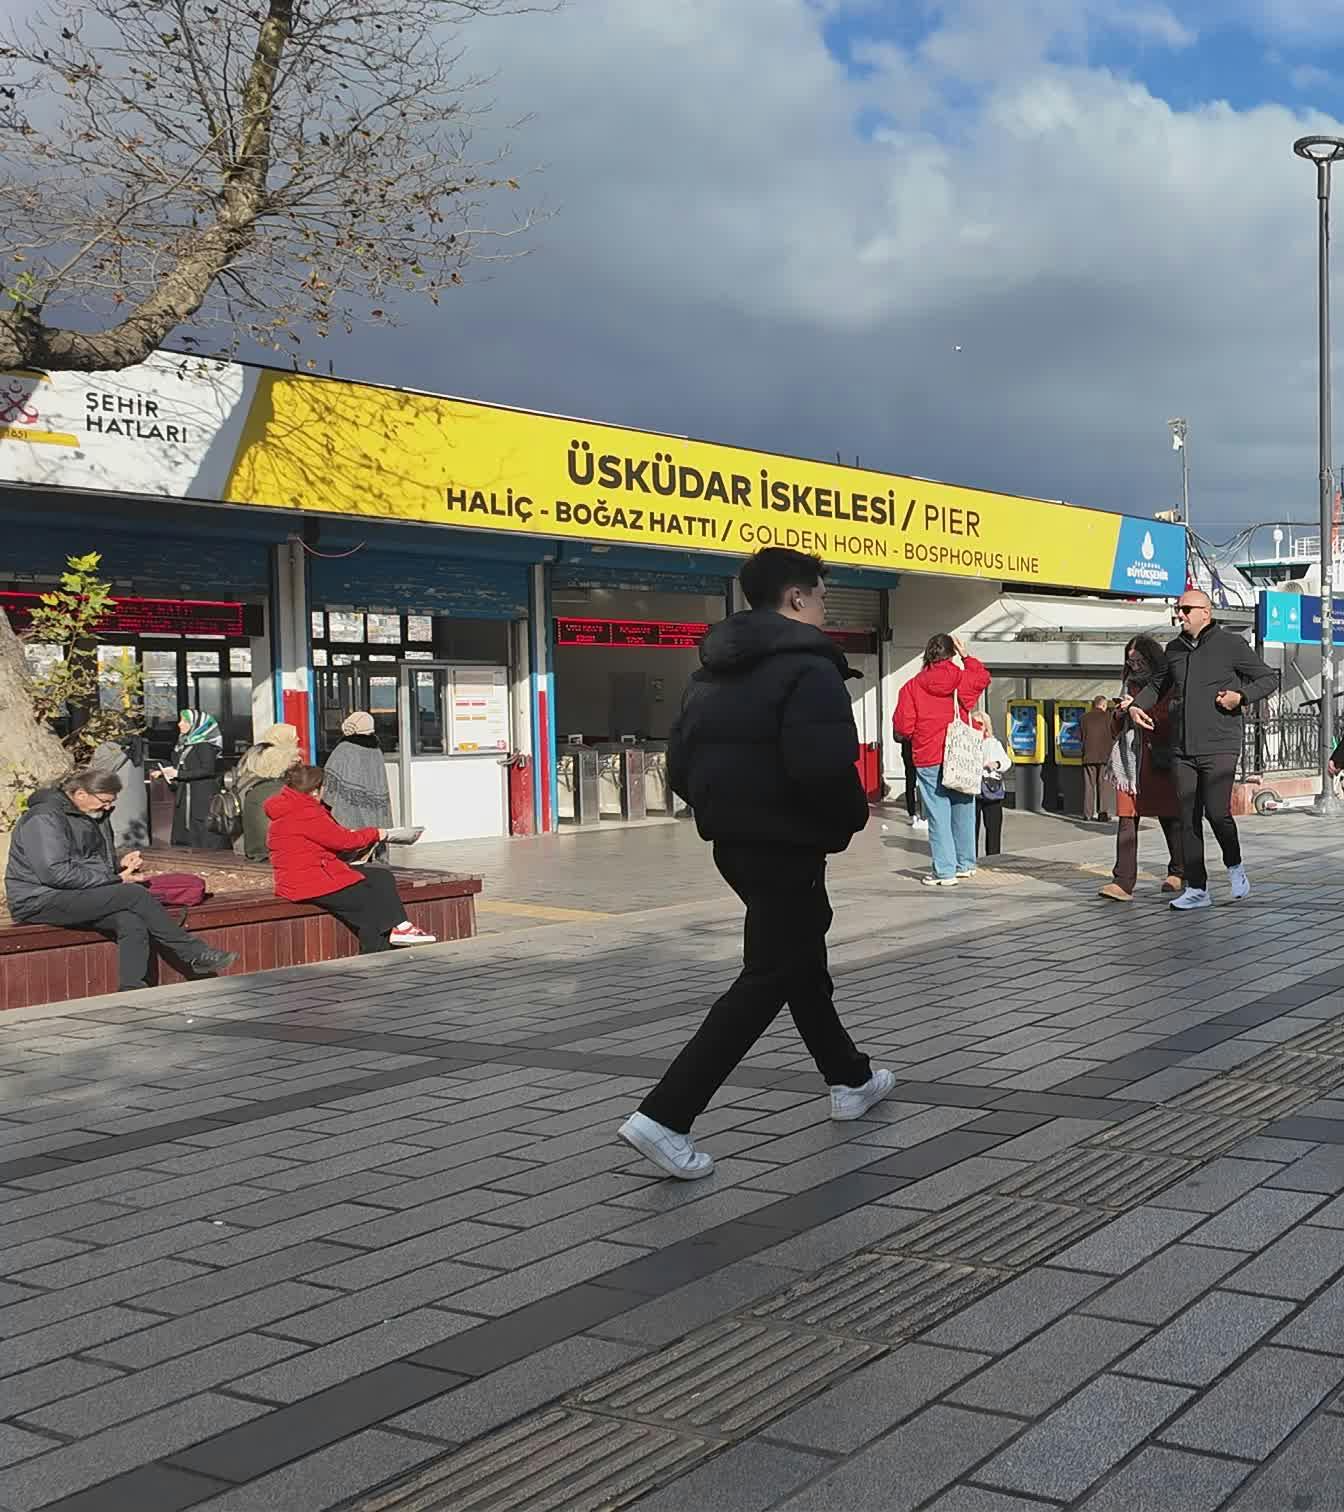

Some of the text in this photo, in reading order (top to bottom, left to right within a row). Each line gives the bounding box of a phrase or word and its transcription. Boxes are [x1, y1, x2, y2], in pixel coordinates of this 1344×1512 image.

[85, 392, 160, 418] ŞEHİR
[85, 414, 188, 444] HATLARI
[567, 439, 752, 507] ÜSKÜDAR
[760, 469, 896, 526] İSKELESİ
[924, 503, 981, 538] PIER
[446, 487, 534, 523] HALİÇ
[555, 499, 644, 531] BOĞAZ
[649, 511, 717, 538] HATTI
[739, 522, 828, 552] GOLDEN
[833, 536, 888, 557] HORN
[903, 542, 1005, 571] BOSPHORUS
[1007, 554, 1040, 574] LINE
